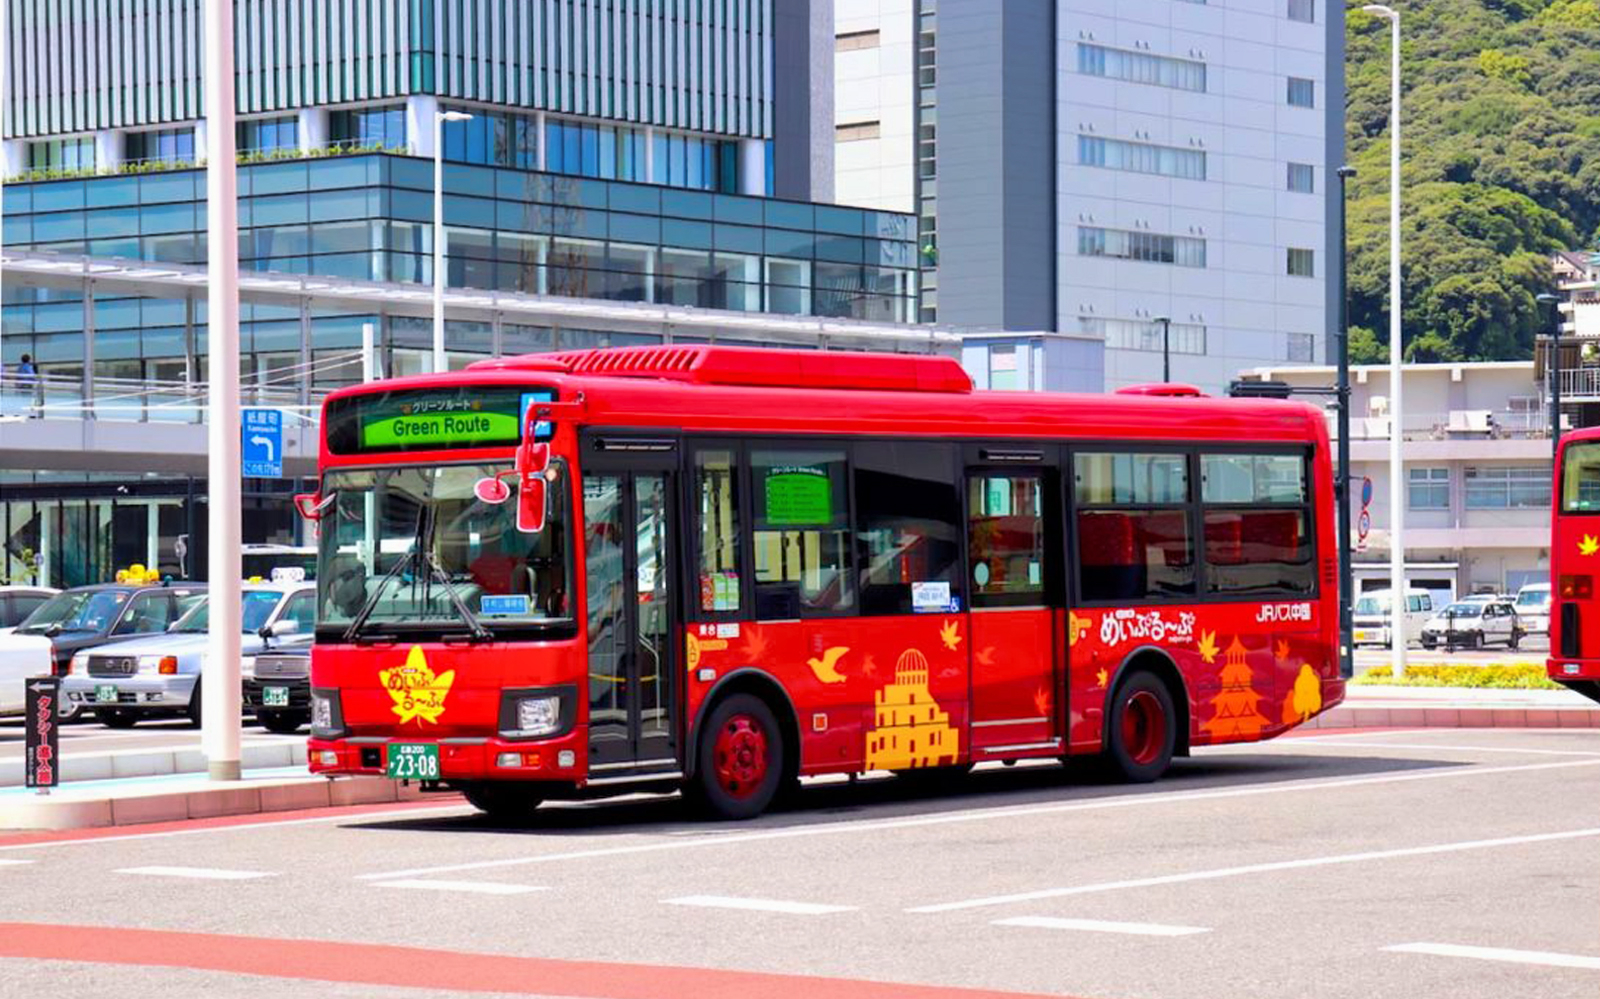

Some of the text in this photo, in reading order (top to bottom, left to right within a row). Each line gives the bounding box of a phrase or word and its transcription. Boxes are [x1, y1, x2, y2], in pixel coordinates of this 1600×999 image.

[412, 400, 471, 413] グリーンルート
[393, 416, 490, 437] Green Route
[1255, 603, 1312, 622] JRバス中国
